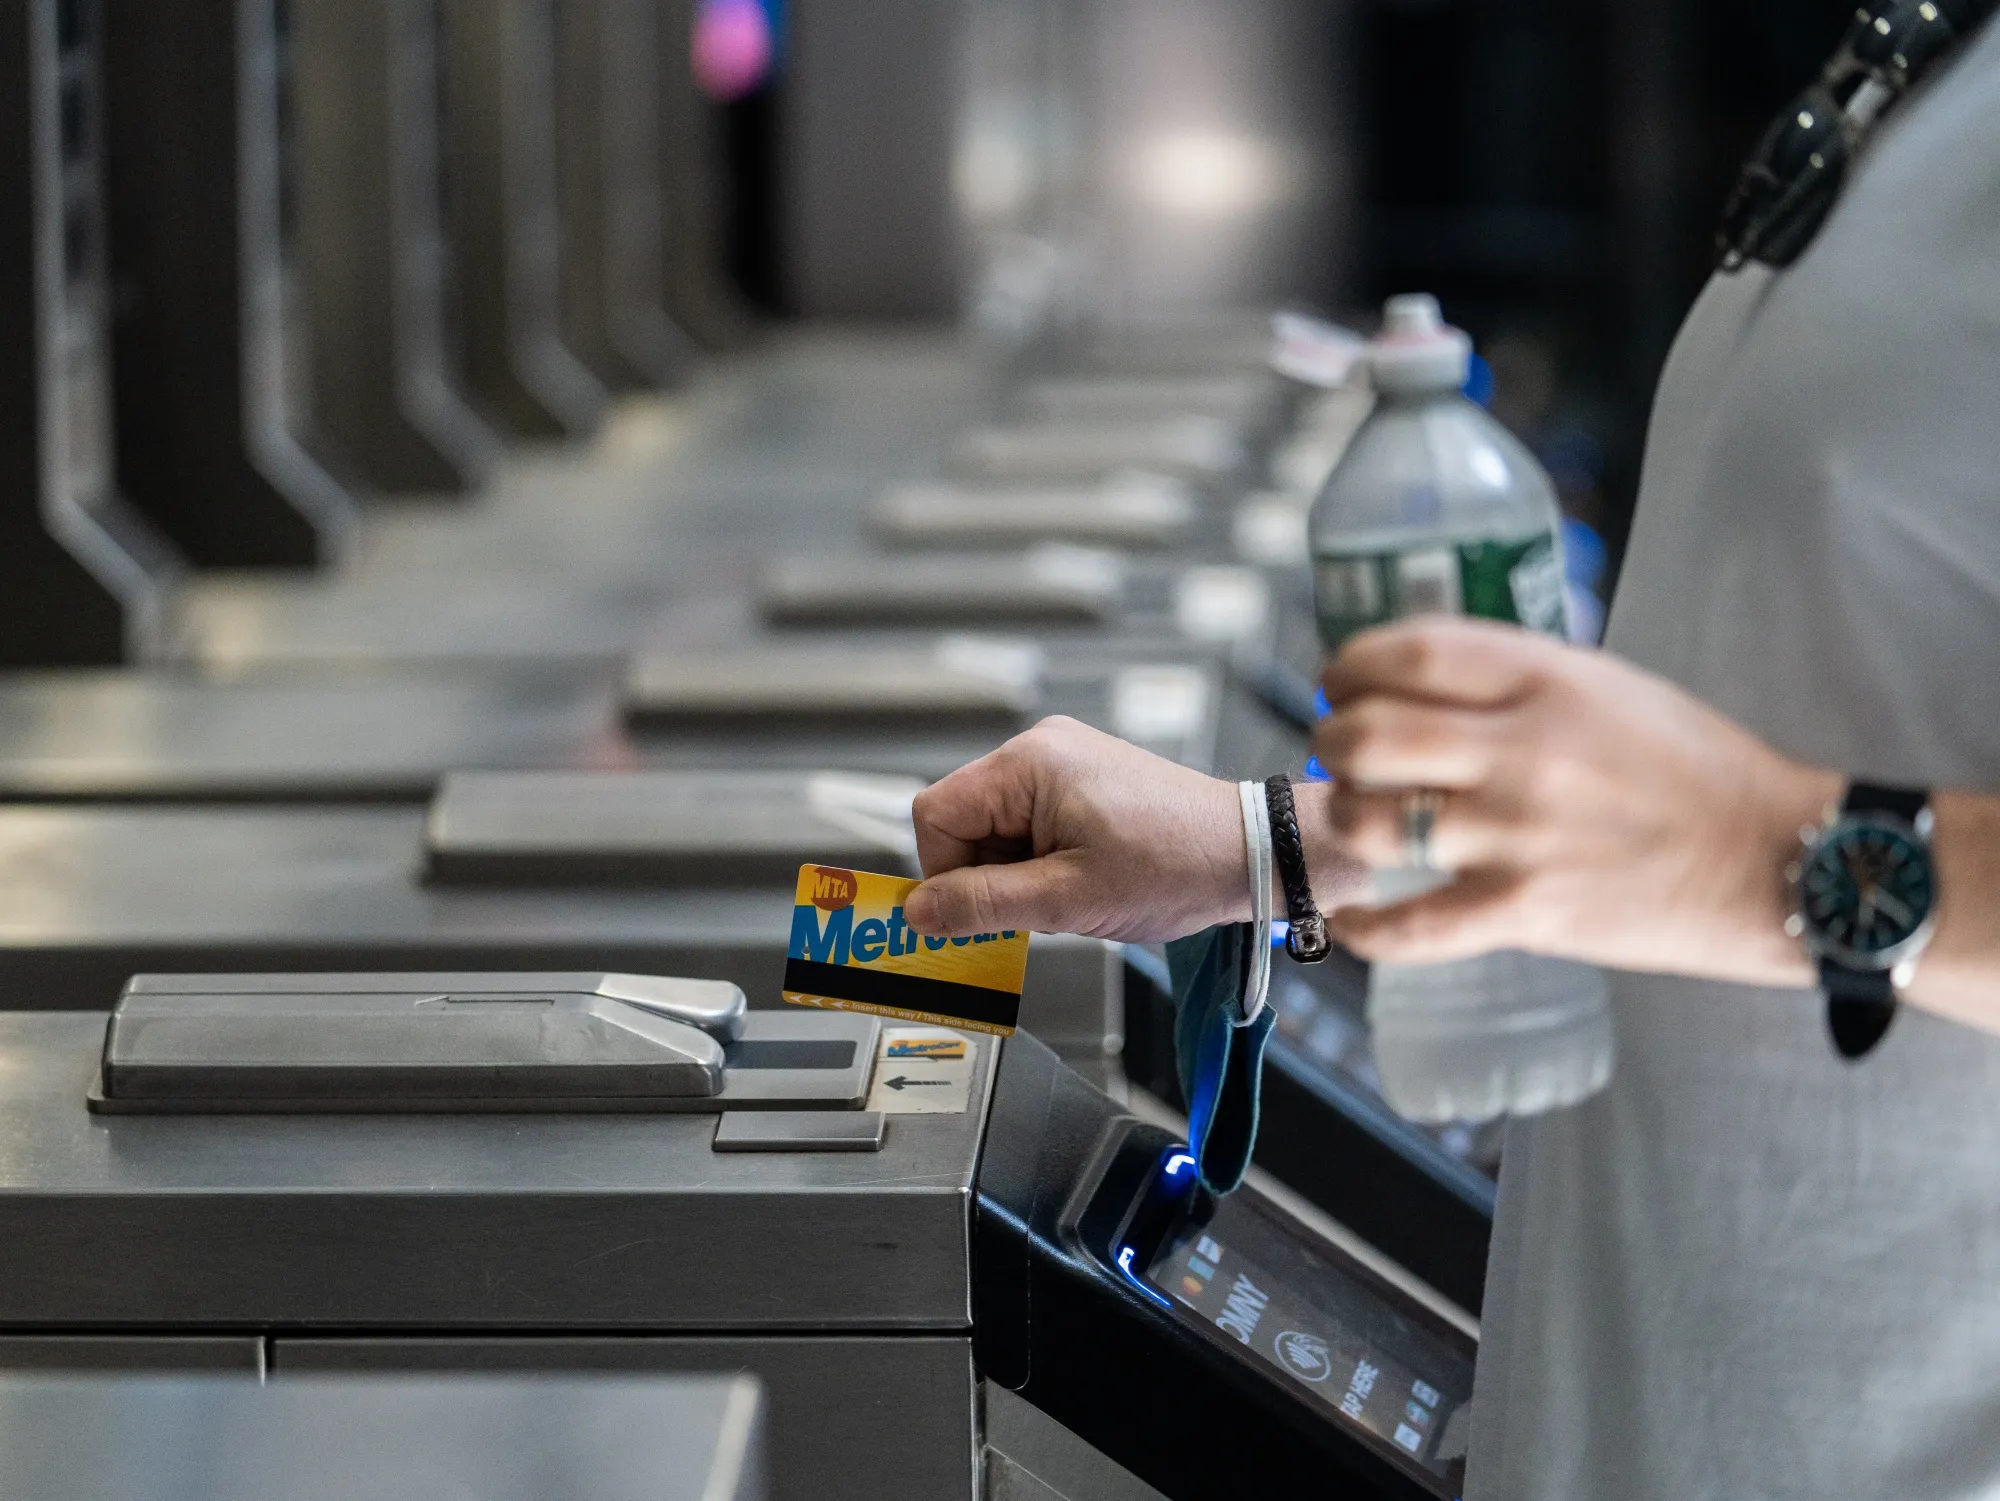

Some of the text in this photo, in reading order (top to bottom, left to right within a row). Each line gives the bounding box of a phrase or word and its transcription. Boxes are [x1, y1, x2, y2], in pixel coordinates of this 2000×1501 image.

[811, 872, 849, 899] MTA
[852, 1001, 877, 1013] Insert
[880, 1006, 896, 1016] this
[898, 1011, 916, 1020] way
[923, 1013, 942, 1023] This
[944, 1017, 962, 1027] side
[964, 1020, 991, 1033] facing
[993, 1026, 1010, 1036] you
[1215, 1273, 1269, 1345] OMNY
